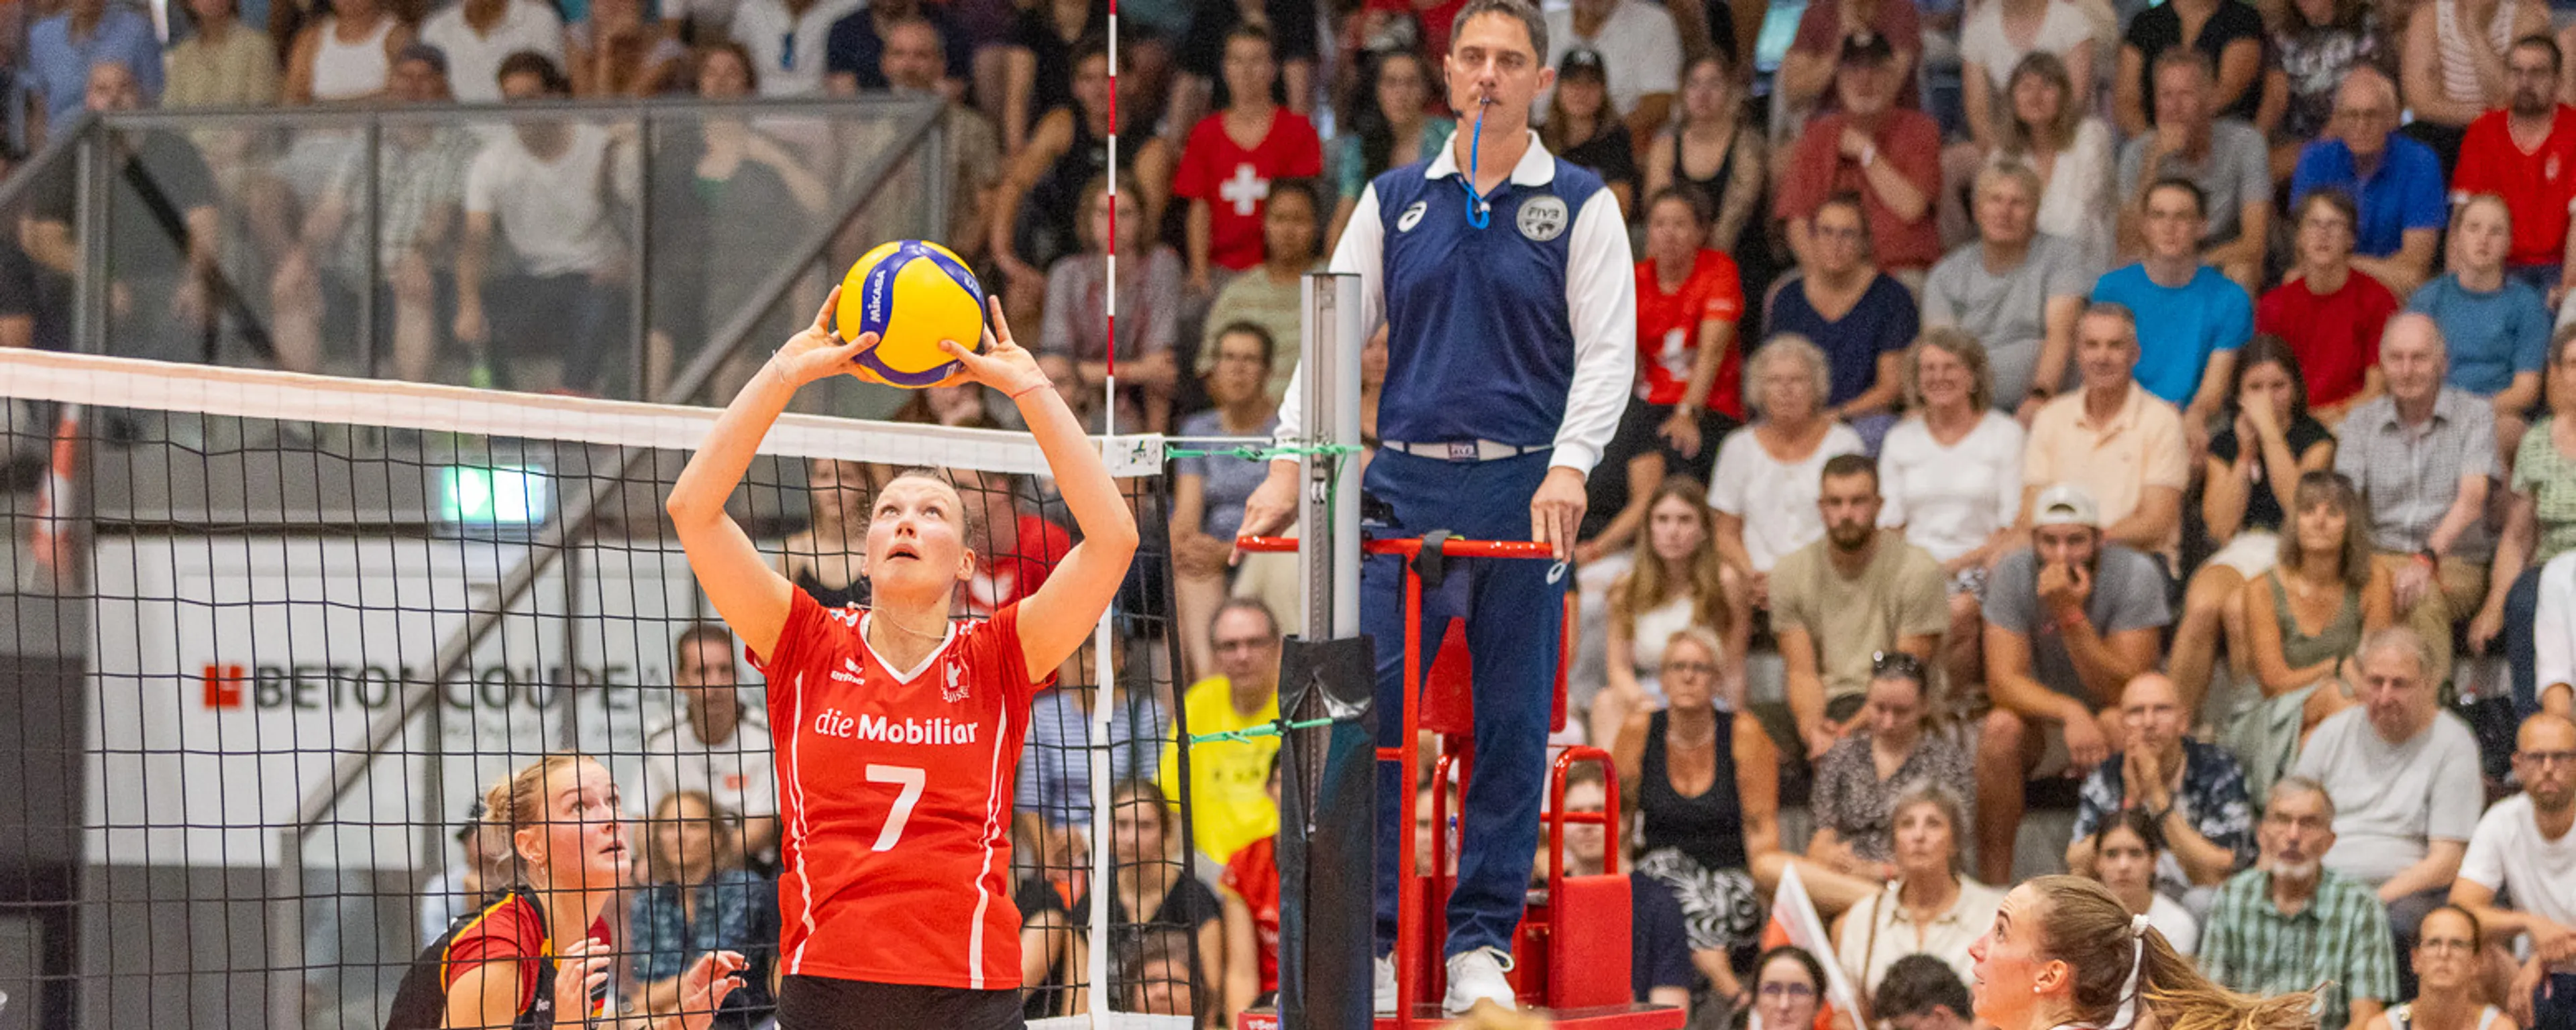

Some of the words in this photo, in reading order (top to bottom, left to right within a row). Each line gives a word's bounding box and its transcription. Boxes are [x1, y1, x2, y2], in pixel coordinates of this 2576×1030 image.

[867, 270, 886, 323] MIKASA
[814, 708, 854, 738] die
[857, 713, 979, 744] Mobiliar
[865, 763, 926, 852] 7
